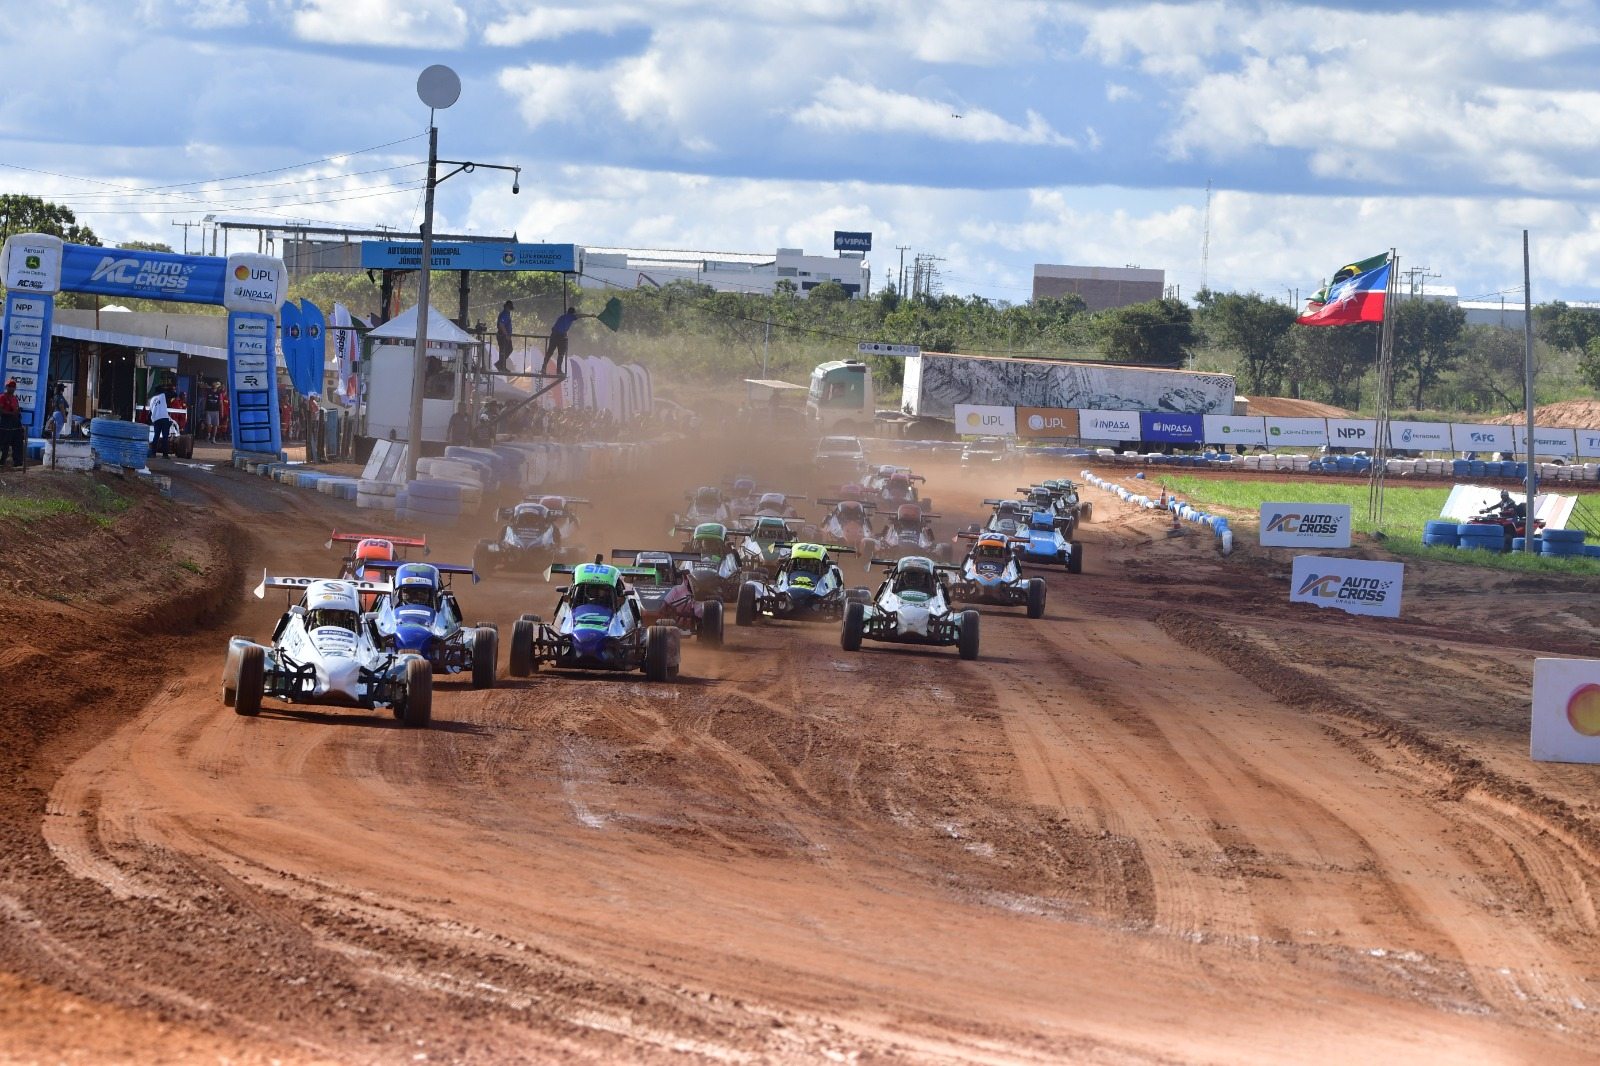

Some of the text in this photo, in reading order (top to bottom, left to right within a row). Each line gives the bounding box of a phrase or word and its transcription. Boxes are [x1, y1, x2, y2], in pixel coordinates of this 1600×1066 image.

[844, 238, 870, 246] VIPAL
[387, 246, 461, 256] AUTÓDROM UNICIPAL
[90, 256, 140, 284] AC
[140, 260, 183, 275] AUTO
[135, 272, 189, 289] CROSS
[251, 268, 274, 282] UPL
[16, 303, 33, 312] NPP
[238, 341, 263, 349] TMG
[982, 415, 1004, 426] UPL
[1044, 417, 1067, 429] UPL
[1099, 420, 1130, 429] INPASA
[1162, 423, 1193, 433] INPASA
[1337, 427, 1366, 439] NPP
[1266, 513, 1301, 533] AC
[1302, 514, 1332, 524] AUTO
[1298, 524, 1338, 534] CROSS
[798, 544, 819, 553] 46
[1297, 573, 1342, 598] AC
[1342, 576, 1380, 590] AUTO
[1337, 587, 1386, 602] CROSS
